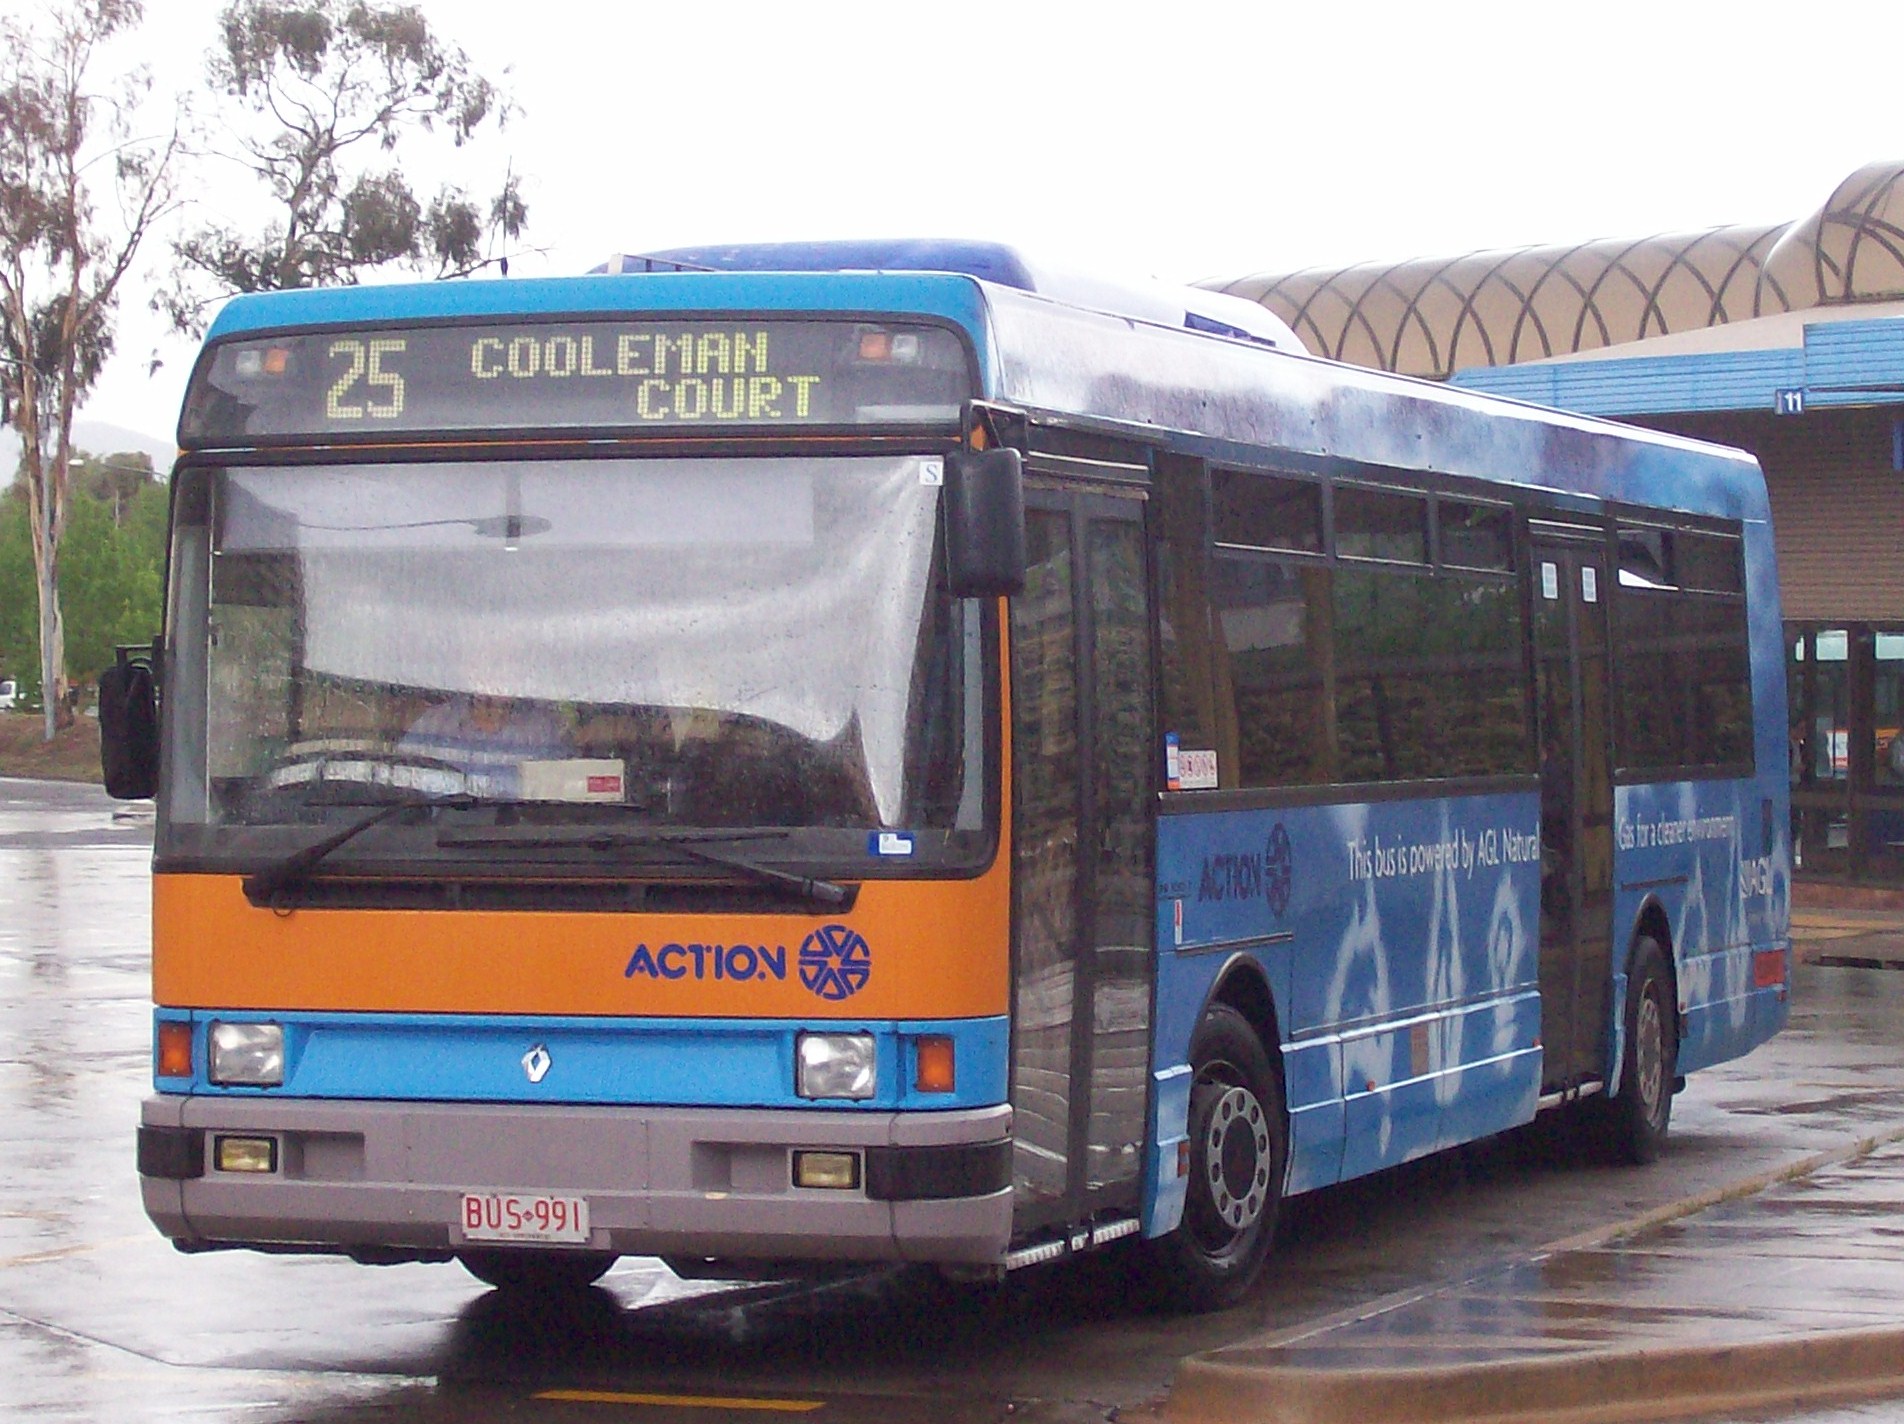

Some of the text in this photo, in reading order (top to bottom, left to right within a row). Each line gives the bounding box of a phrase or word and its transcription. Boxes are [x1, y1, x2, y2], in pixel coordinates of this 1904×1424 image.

[327, 331, 768, 419] 25 COOLEMAN
[636, 375, 821, 420] COURT
[1784, 391, 1803, 412] 11
[925, 463, 939, 483] S
[1347, 821, 1540, 881] This bus is powered by AGL Natural
[1199, 852, 1261, 902] ACTION
